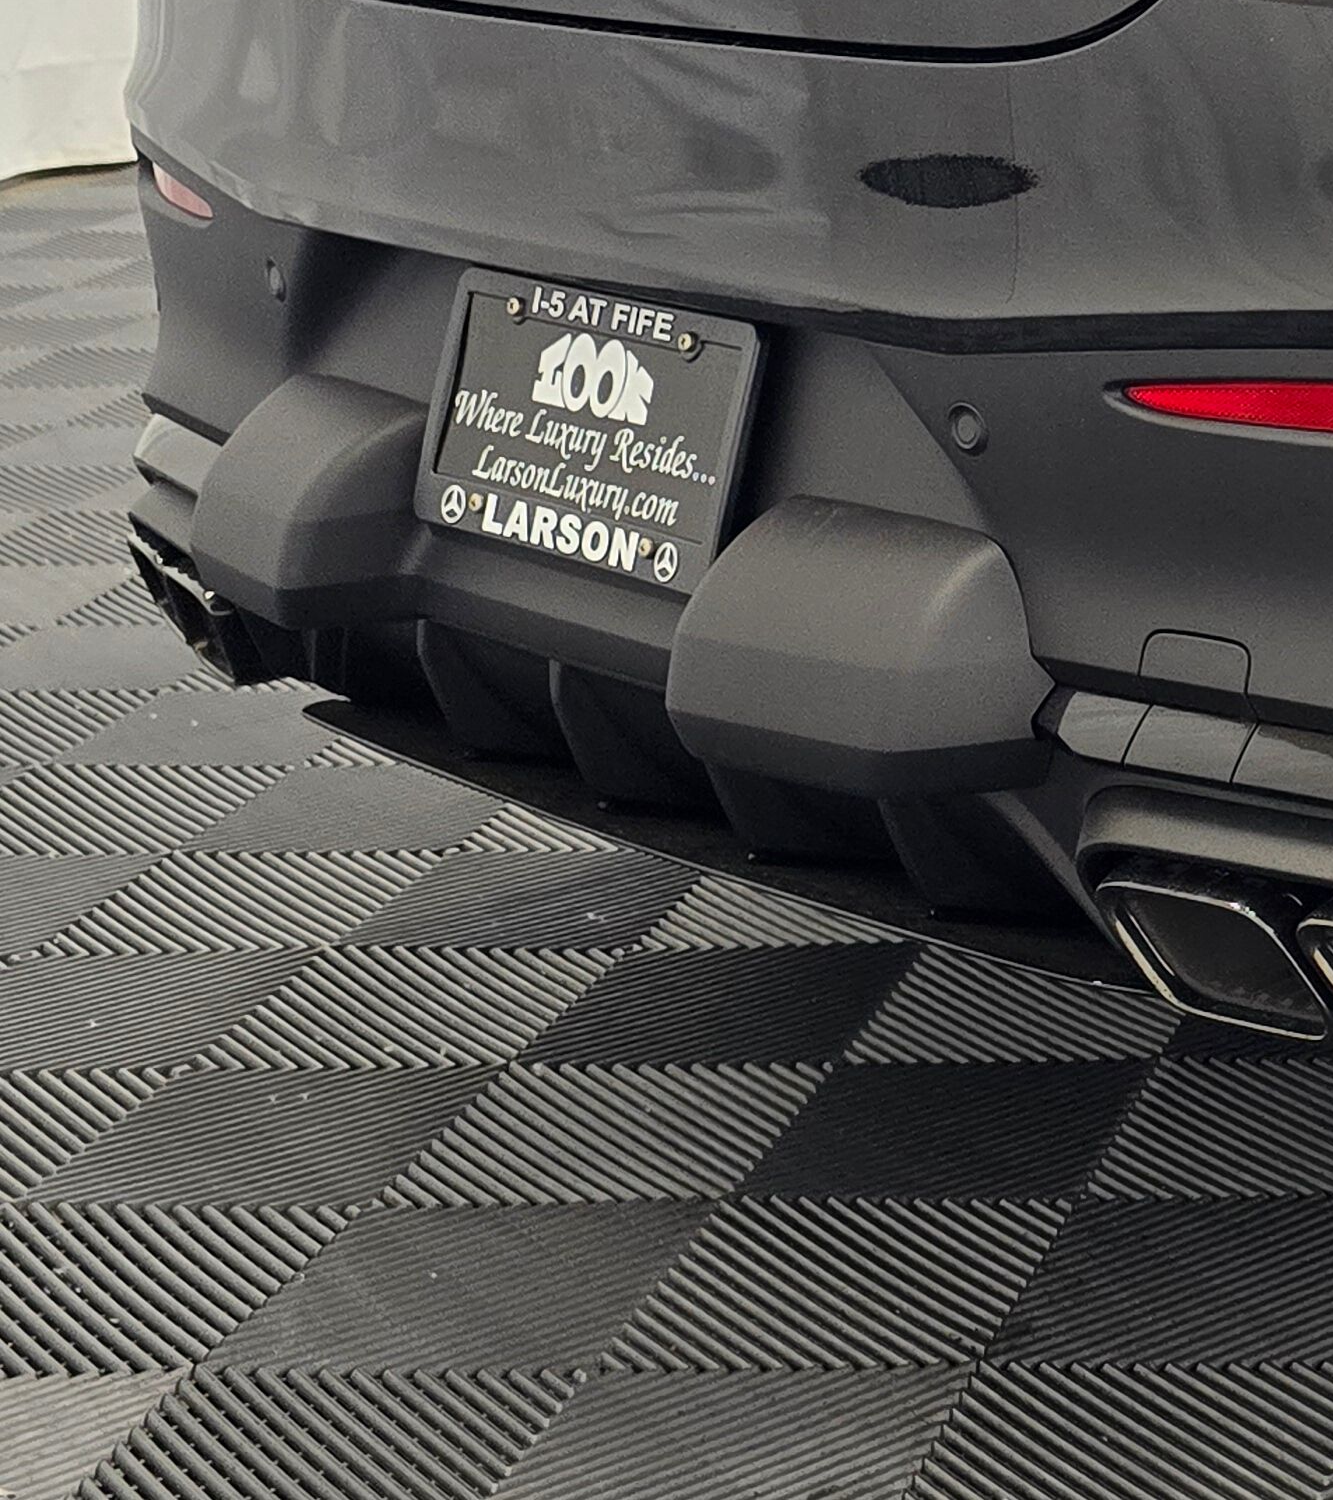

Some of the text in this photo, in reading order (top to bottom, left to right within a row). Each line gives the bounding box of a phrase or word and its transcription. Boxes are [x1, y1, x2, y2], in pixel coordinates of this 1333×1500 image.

[531, 286, 675, 342] I-5 AT FIFE
[455, 389, 717, 486] Where Luxury Resides...
[471, 445, 680, 527] LarsonLuxury.com
[481, 493, 641, 572] LARSON
